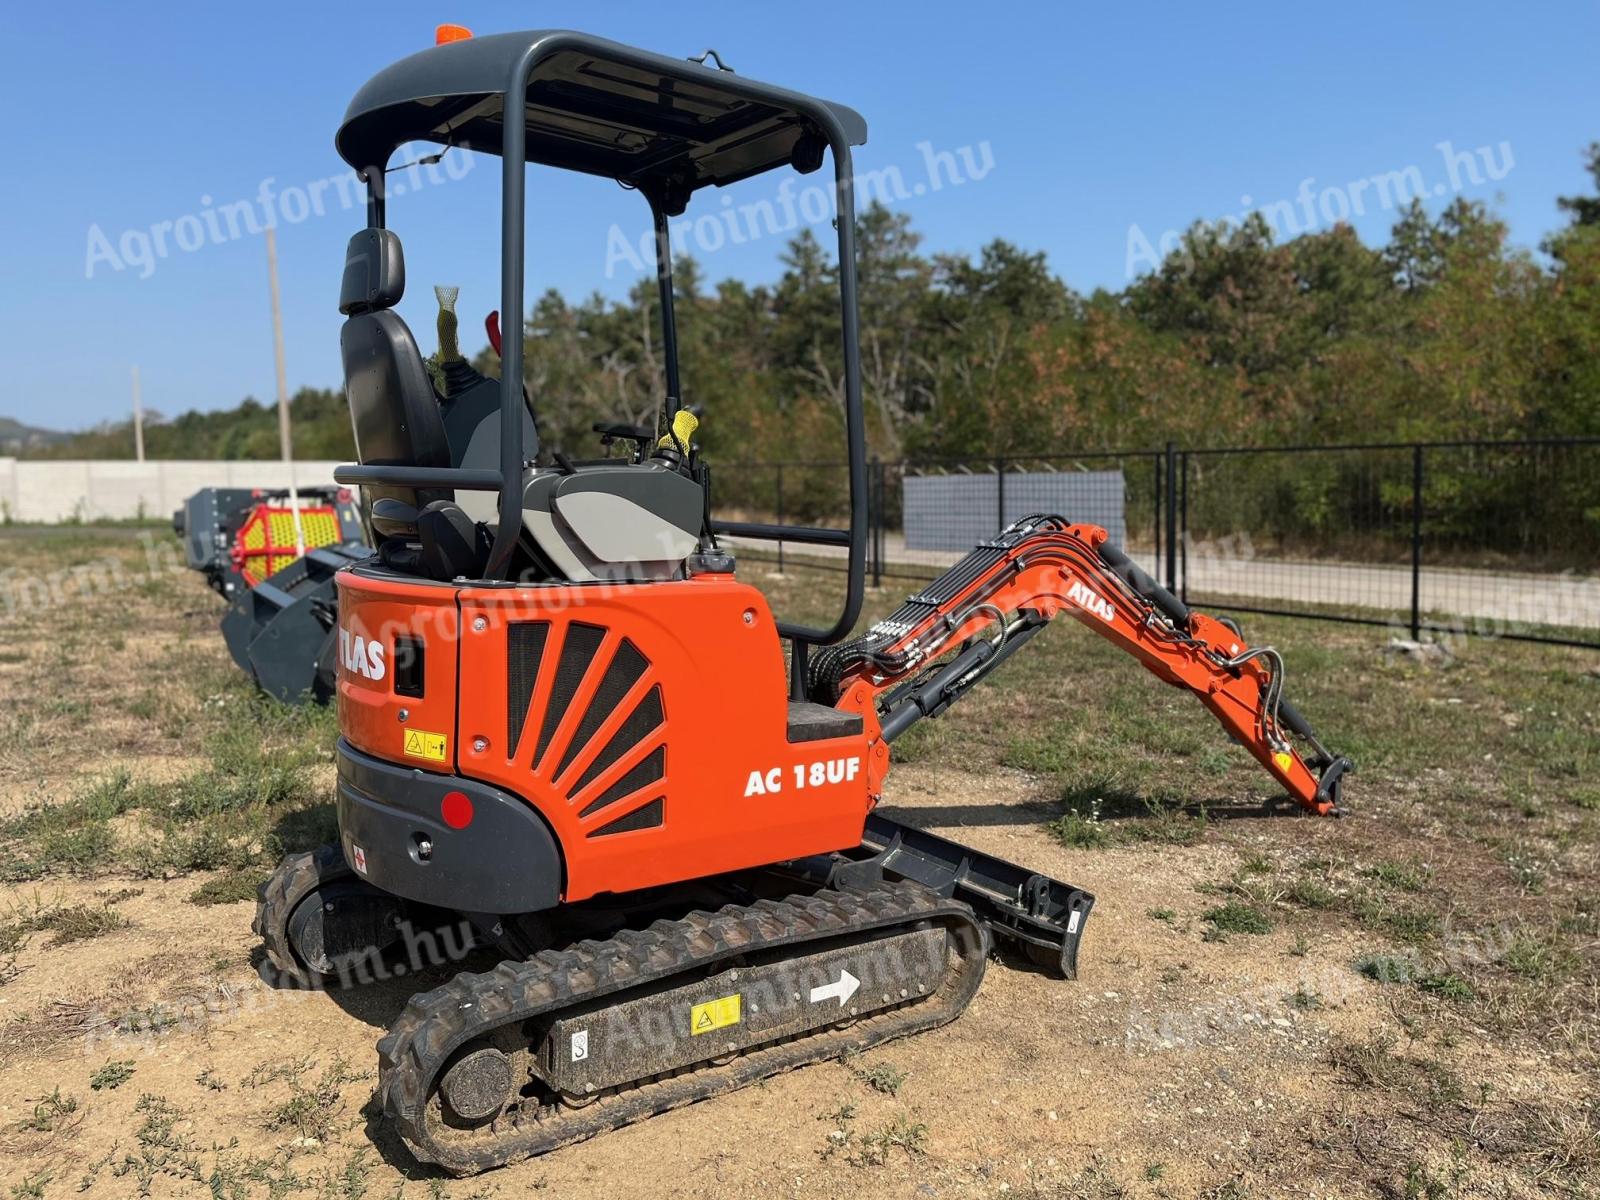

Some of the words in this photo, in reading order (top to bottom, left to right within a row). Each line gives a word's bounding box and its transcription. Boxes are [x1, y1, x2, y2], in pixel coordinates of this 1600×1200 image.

[1066, 581, 1116, 621] ATLAS
[338, 624, 386, 680] TLAS
[744, 767, 782, 797] AC
[793, 757, 860, 789] 18UF
